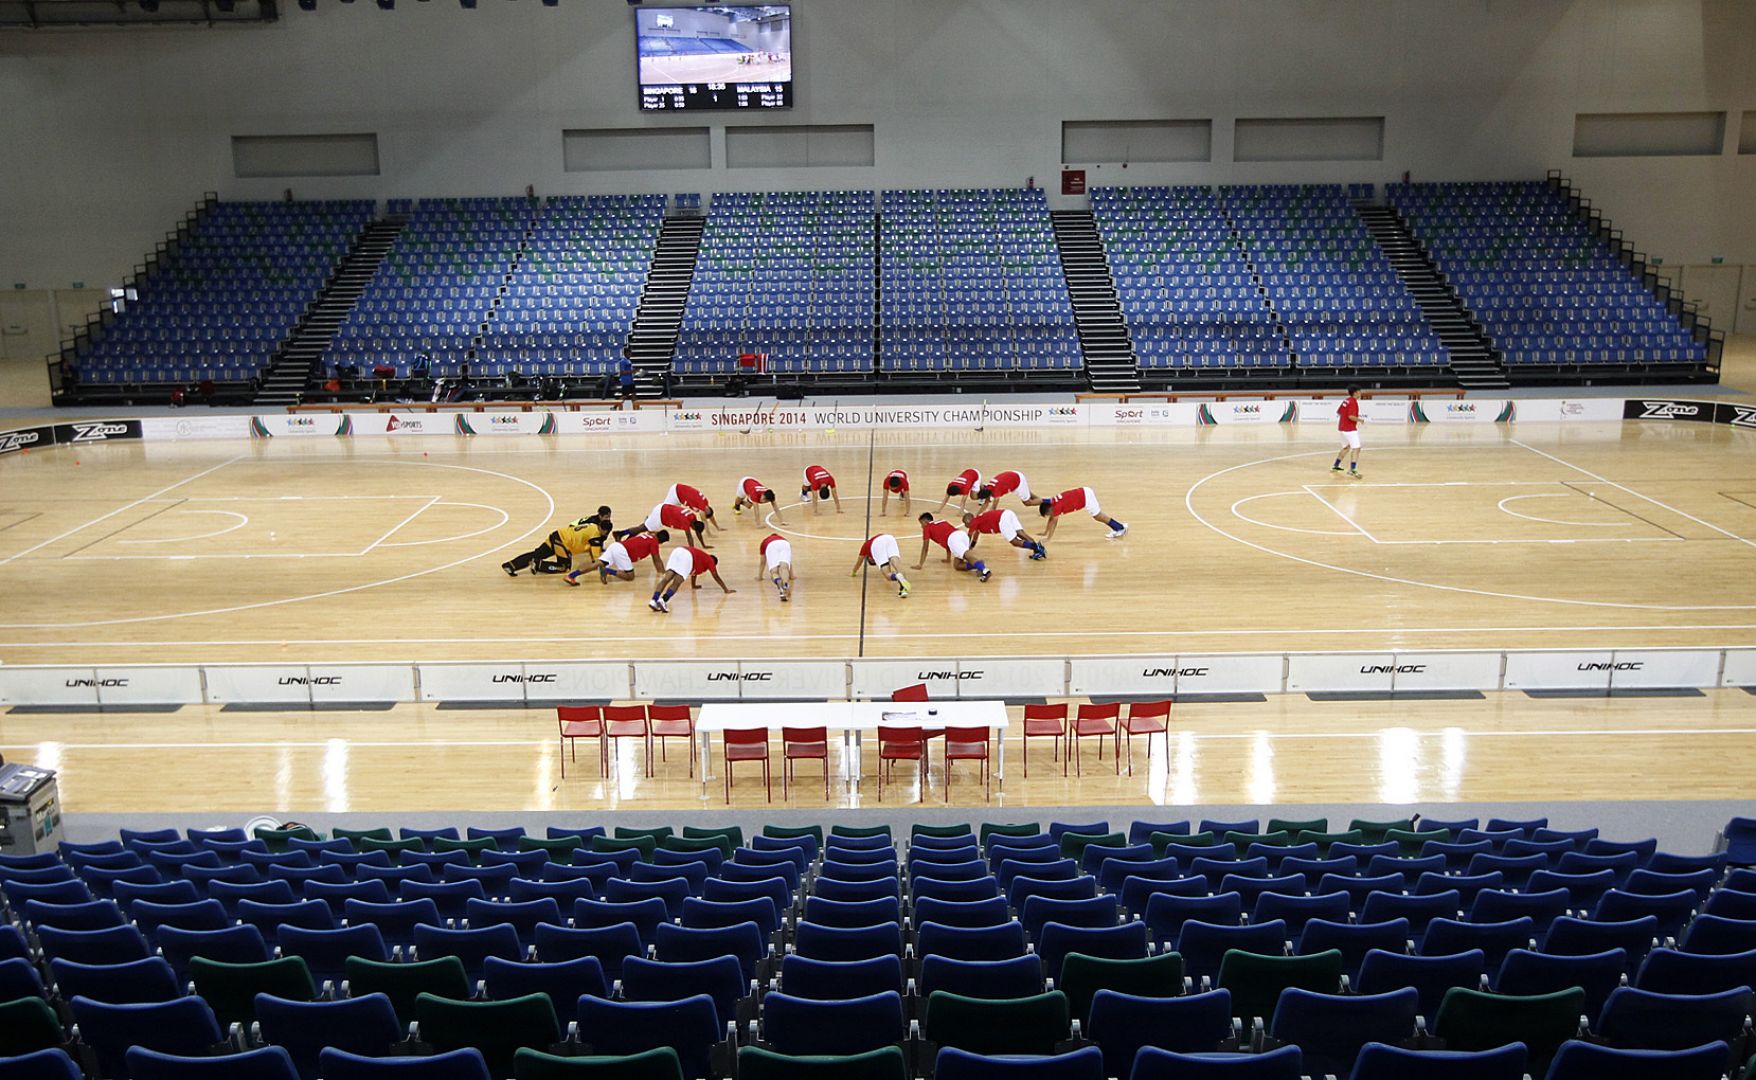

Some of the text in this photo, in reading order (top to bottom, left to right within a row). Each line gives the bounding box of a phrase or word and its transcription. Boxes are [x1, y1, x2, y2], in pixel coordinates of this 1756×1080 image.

[711, 413, 775, 426] SINGAPORE
[779, 412, 807, 425] 2014
[814, 412, 861, 424] WORLD
[864, 411, 940, 424] UNIVERSITY
[943, 409, 1043, 423] CHAMPIONSHIP
[1639, 401, 1699, 419] Zone
[582, 416, 611, 427] Sport
[72, 423, 128, 441] Zone
